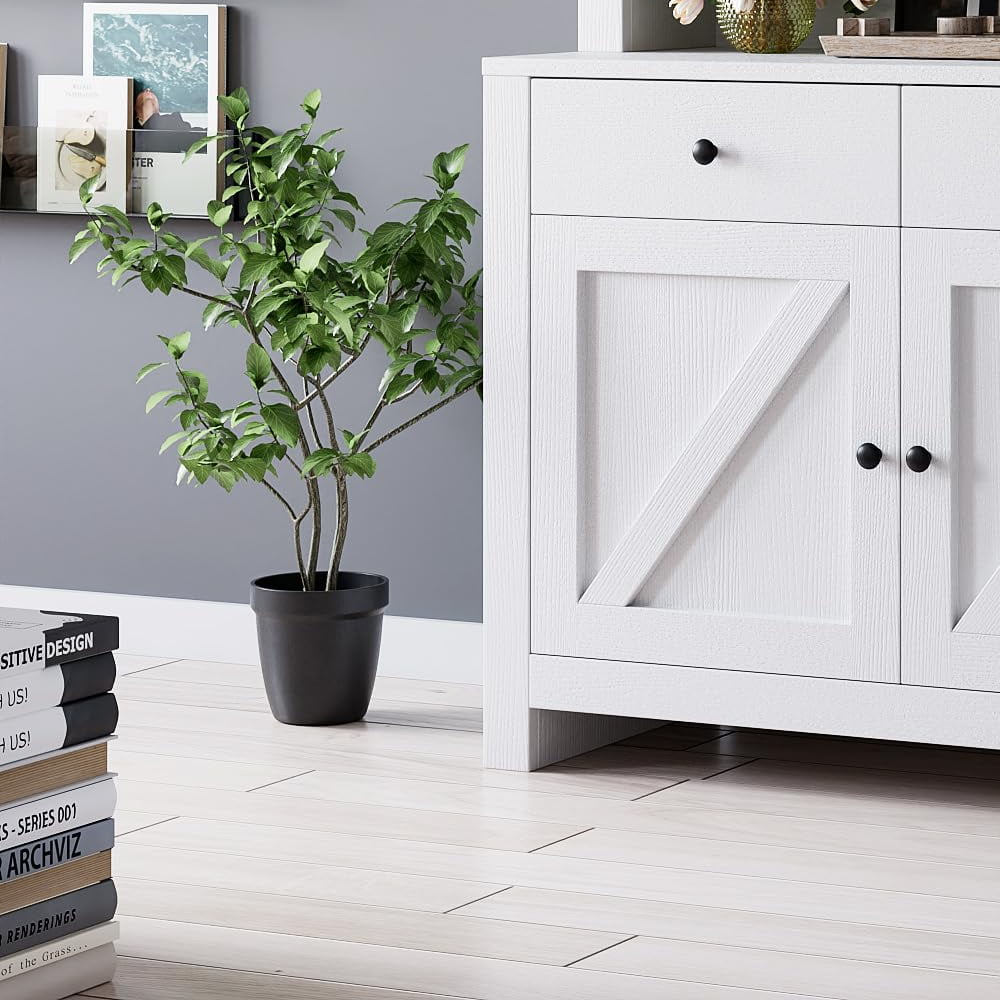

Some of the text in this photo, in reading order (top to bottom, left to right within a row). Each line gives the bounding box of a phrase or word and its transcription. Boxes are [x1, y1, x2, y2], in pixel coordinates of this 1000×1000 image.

[46, 631, 94, 659] DESIGN
[8, 687, 28, 707] US!
[10, 730, 31, 751] US!
[17, 809, 55, 836] SERIES
[57, 802, 77, 823] 001
[7, 831, 82, 879] ARCHVIZ
[6, 908, 76, 944] RENDERINGS
[1, 963, 13, 976] of
[20, 958, 37, 970] the
